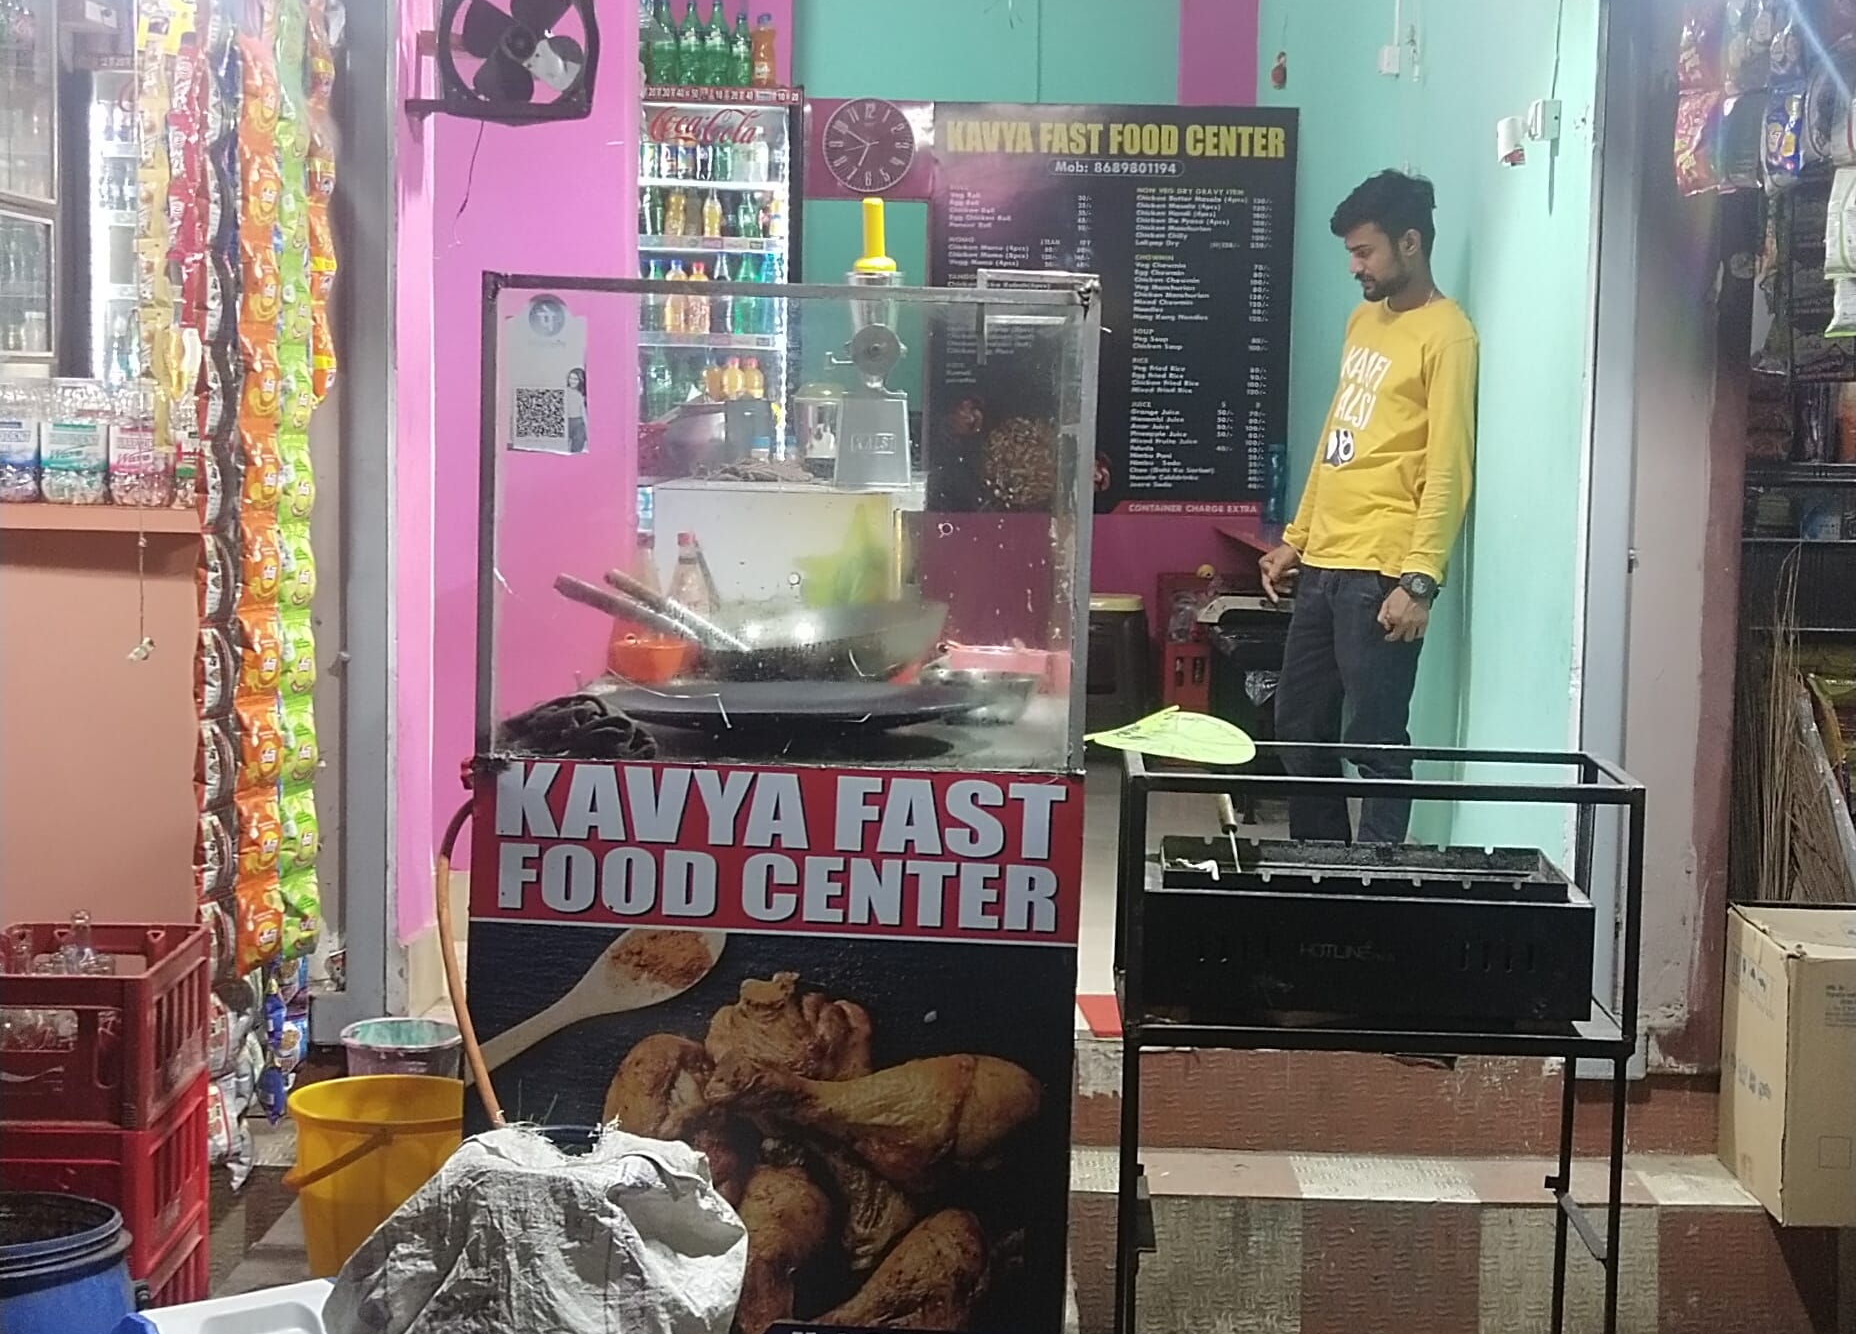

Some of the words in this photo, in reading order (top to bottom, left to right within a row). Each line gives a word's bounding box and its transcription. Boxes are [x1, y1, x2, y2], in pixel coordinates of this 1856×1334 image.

[947, 120, 1034, 153] KAVYA
[1040, 122, 1104, 155] FAST
[1109, 123, 1179, 156] FOOD
[1186, 124, 1285, 158] CENTER
[1055, 160, 1089, 173] Mob:
[1094, 161, 1177, 175] 8689801194
[1129, 504, 1182, 513] CONTAINER
[1185, 505, 1224, 513] CHARGE
[1227, 505, 1257, 513] EXTRA
[494, 763, 808, 850] KAVYA
[834, 775, 1067, 861] FAST
[497, 841, 718, 918] FOOD
[741, 853, 1060, 934] CENTER
